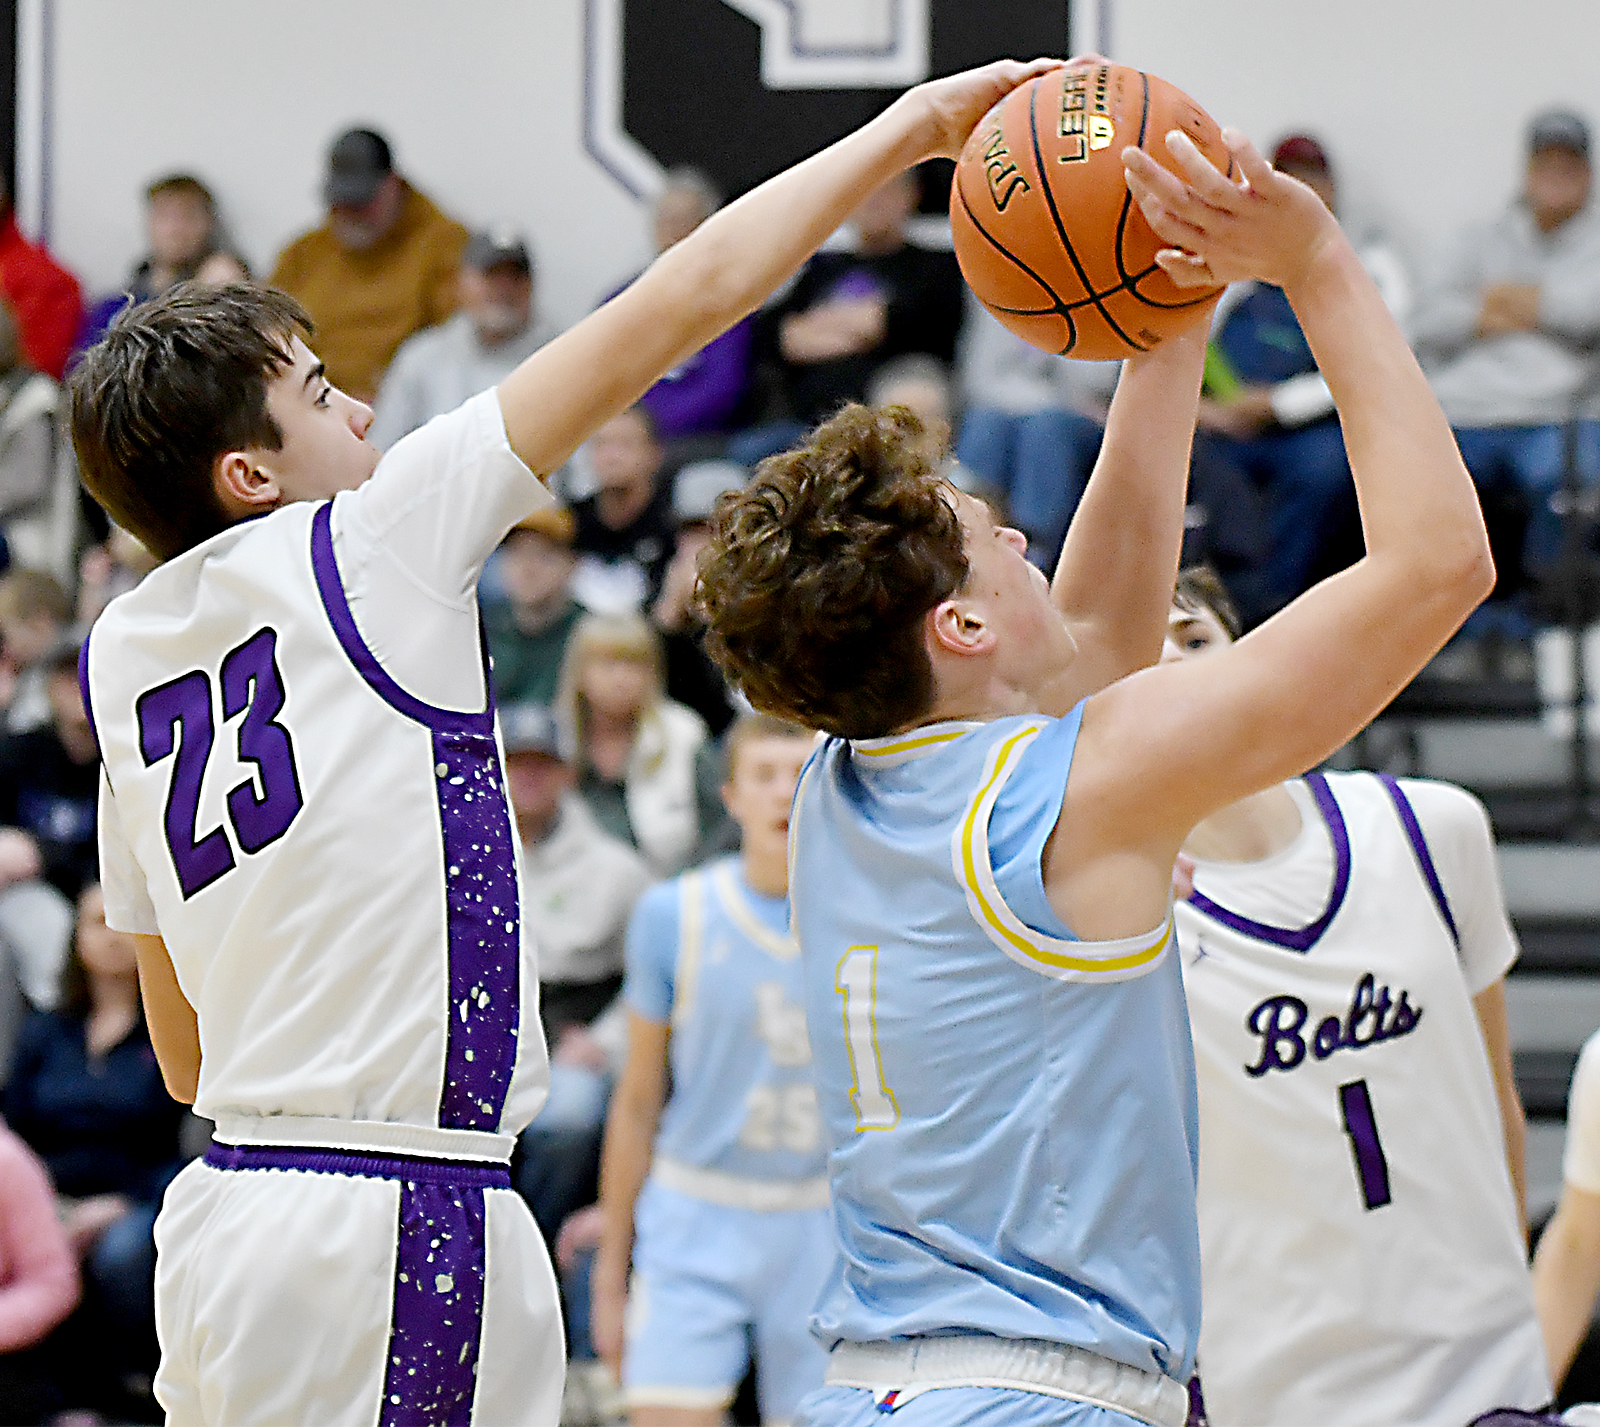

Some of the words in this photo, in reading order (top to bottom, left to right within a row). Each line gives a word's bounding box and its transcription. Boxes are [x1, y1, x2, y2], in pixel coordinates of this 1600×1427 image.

[136, 626, 304, 902] 23
[835, 945, 900, 1132] 1
[1245, 973, 1423, 1076] Bolts
[1338, 1079, 1391, 1210] 1
